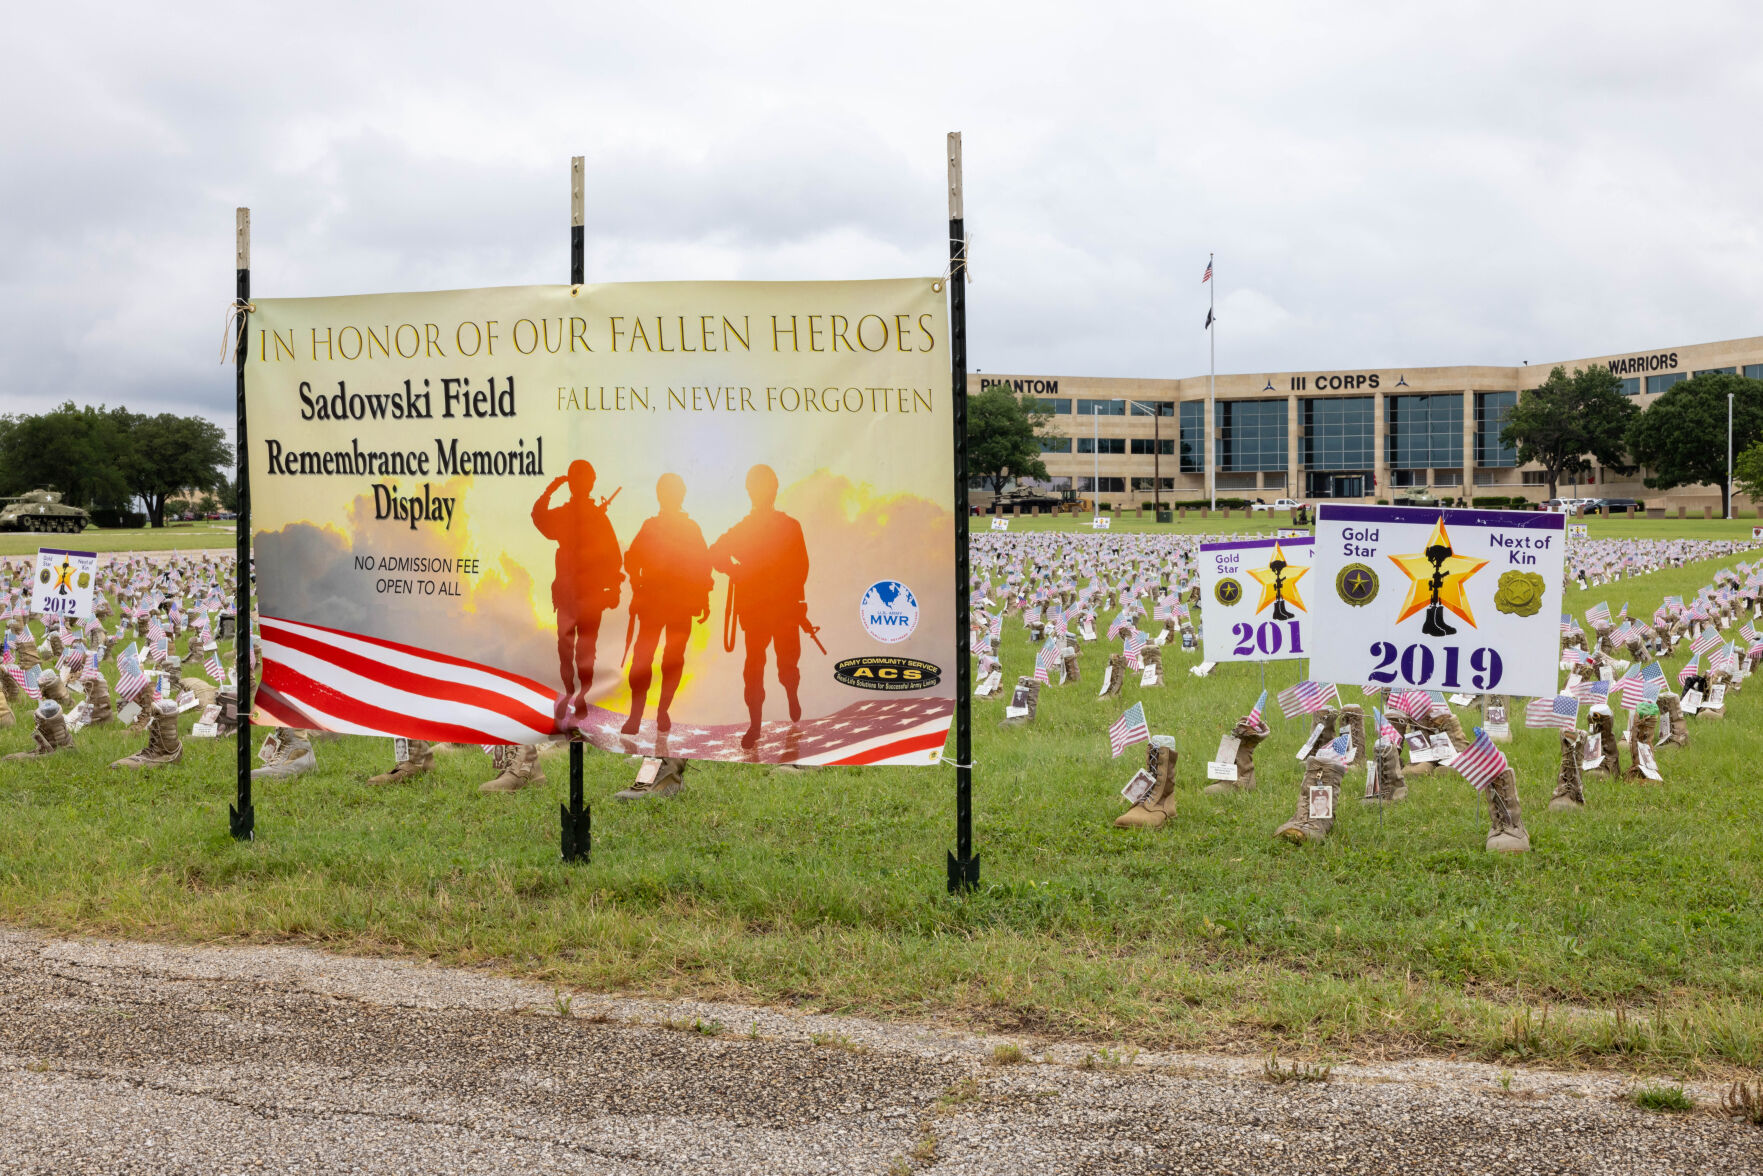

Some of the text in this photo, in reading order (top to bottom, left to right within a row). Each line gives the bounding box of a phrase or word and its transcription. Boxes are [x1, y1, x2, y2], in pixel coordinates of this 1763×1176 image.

[259, 313, 935, 362] IN HONOR OF OUR FALLEN HEROES
[1608, 352, 1678, 374] WARRIORS
[1290, 374, 1380, 390] III CORPS
[299, 375, 516, 421] Sadowski Field
[557, 386, 933, 414] FALLEN, NEVER FORGOTTEN
[264, 436, 544, 476] Remembrance Memorial
[371, 483, 456, 530] Display
[1342, 528, 1379, 542] Gold
[1490, 534, 1552, 550] Next of
[1215, 554, 1240, 564] Gold
[1343, 544, 1376, 558] Star
[1509, 550, 1536, 565] Kin
[354, 556, 479, 574] NO ADMISSION FEE
[1217, 564, 1239, 574] Star
[376, 578, 462, 596] OPEN TO ALL
[43, 596, 76, 614] 2012
[870, 615, 909, 626] MWR
[1232, 620, 1304, 656] 201
[839, 658, 938, 673] ARMY COMMUNITY SERVICE
[853, 667, 922, 680] ACS
[1368, 641, 1503, 690] 2019
